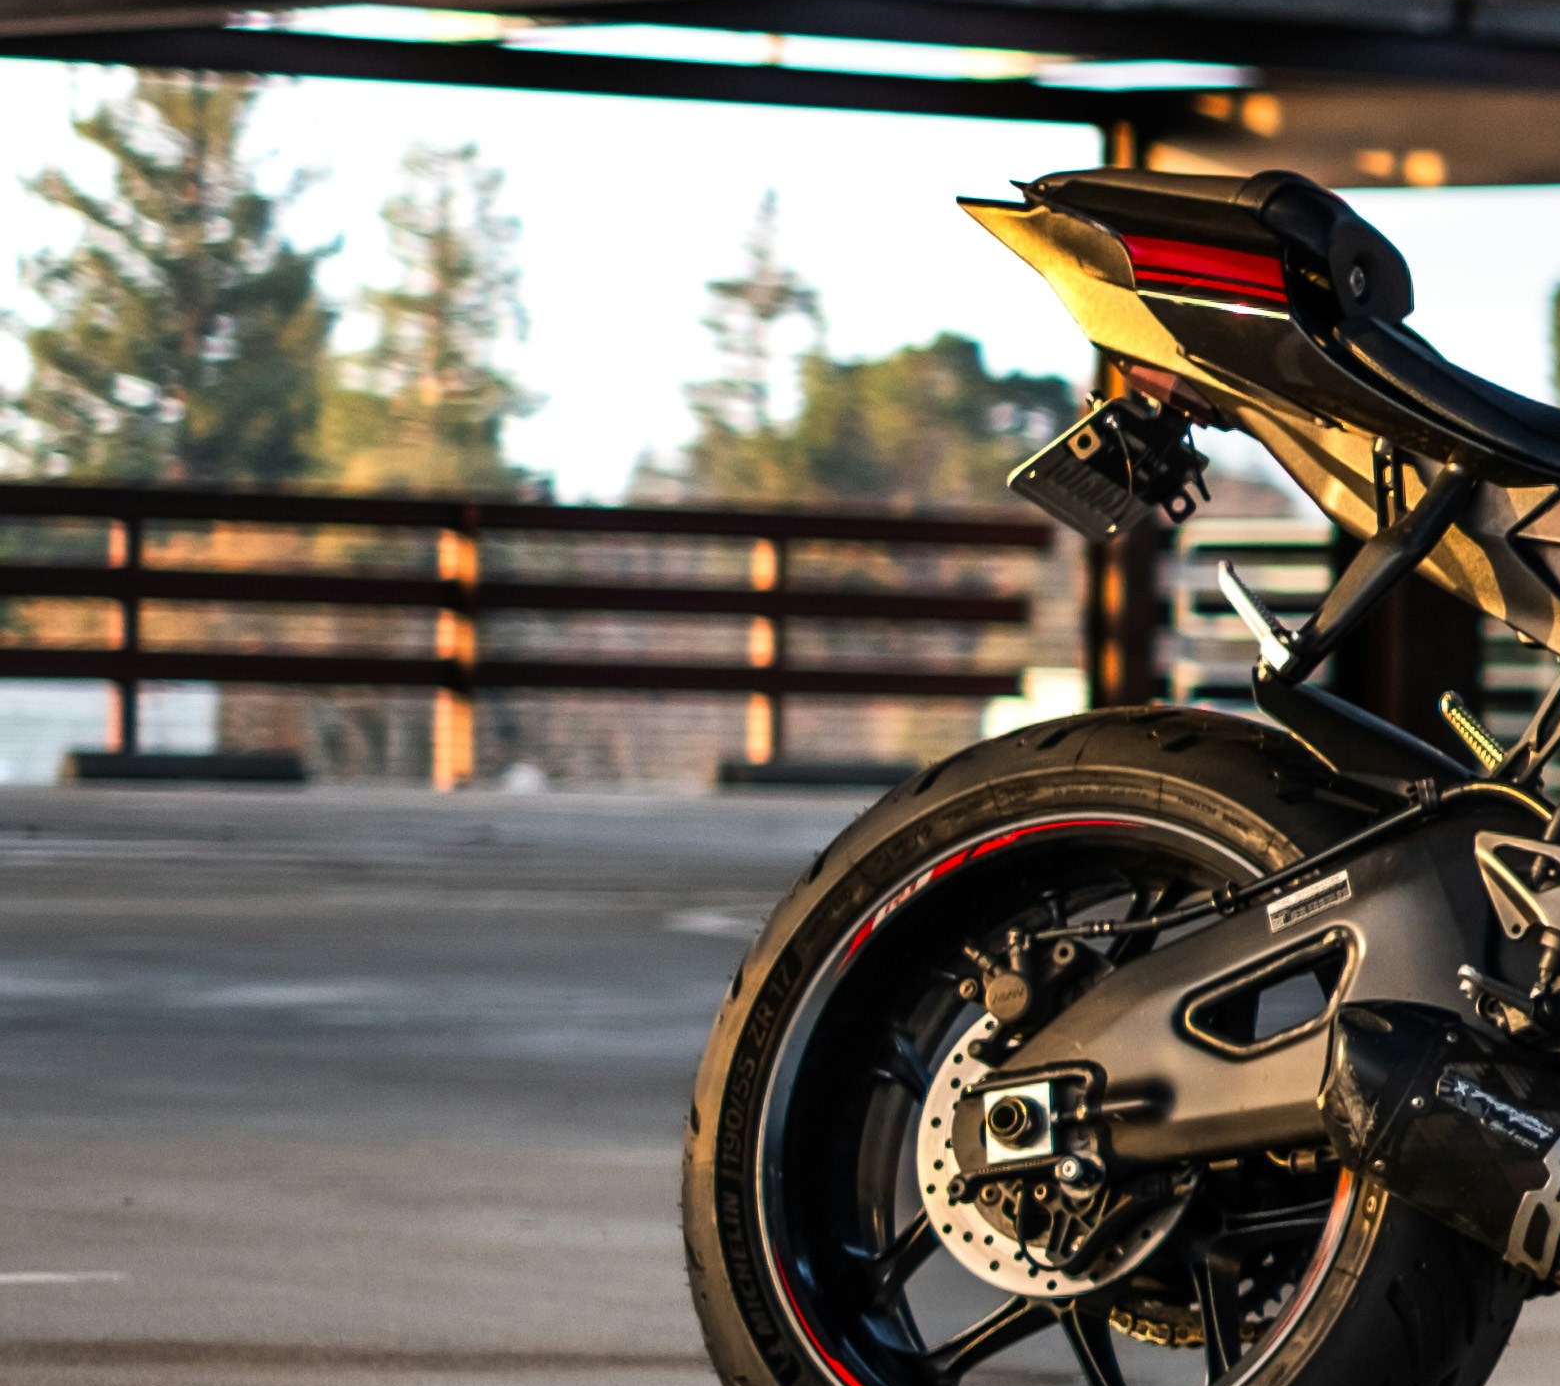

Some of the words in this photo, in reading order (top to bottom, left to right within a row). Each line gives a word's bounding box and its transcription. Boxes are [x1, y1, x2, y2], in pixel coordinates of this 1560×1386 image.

[769, 962, 794, 998] 17
[748, 1002, 775, 1048] ZR
[721, 1055, 756, 1164] 190/55
[721, 1189, 776, 1337] MICHELIN
